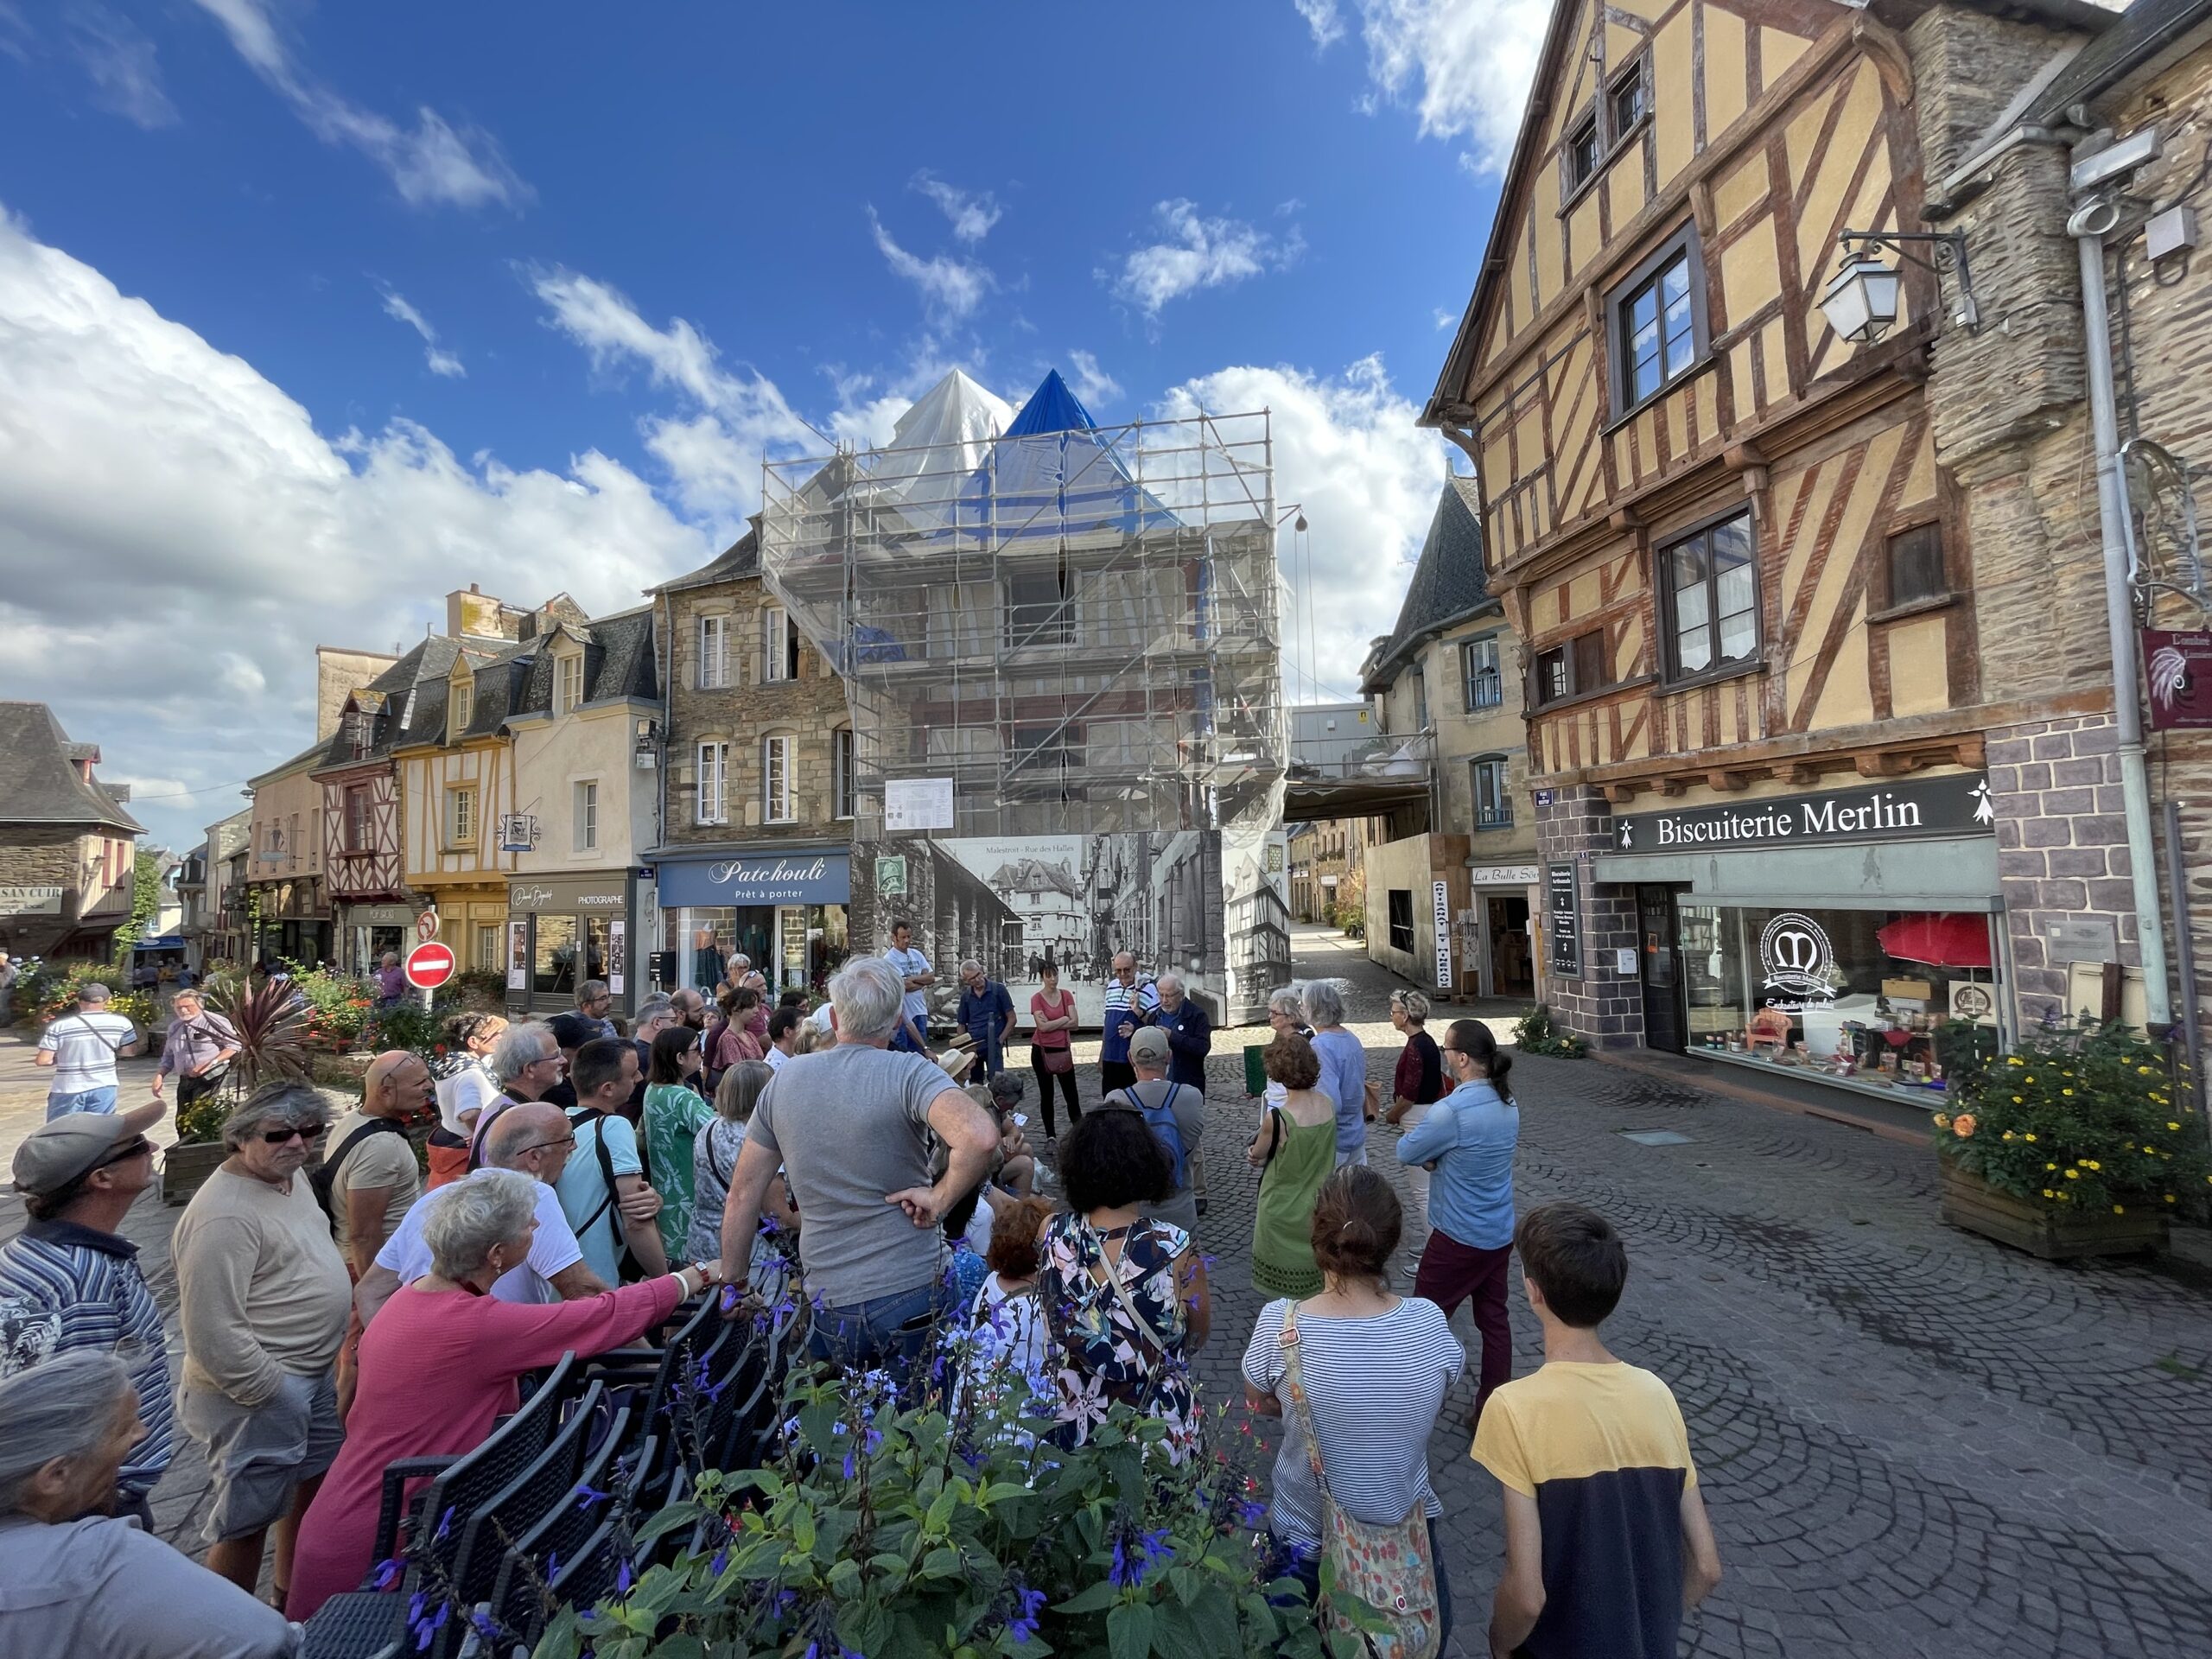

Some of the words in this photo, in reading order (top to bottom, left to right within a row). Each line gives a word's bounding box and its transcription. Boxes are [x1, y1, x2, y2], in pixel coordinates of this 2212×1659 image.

[1656, 805, 1793, 845] Biscuiterie
[1801, 792, 1923, 835] Merlin
[709, 857, 827, 883] Patchouli
[1474, 870, 1488, 881] La
[1492, 868, 1516, 880] Bulle
[29, 888, 61, 898] CUIR
[735, 890, 756, 899] Prêt
[760, 890, 766, 899] à
[769, 890, 803, 899] porter
[578, 895, 623, 905] PHOTOGRAPHE
[1435, 883, 1446, 925] ARTISANAT
[1439, 933, 1446, 942] ET
[1438, 949, 1449, 987] MINERAUX
